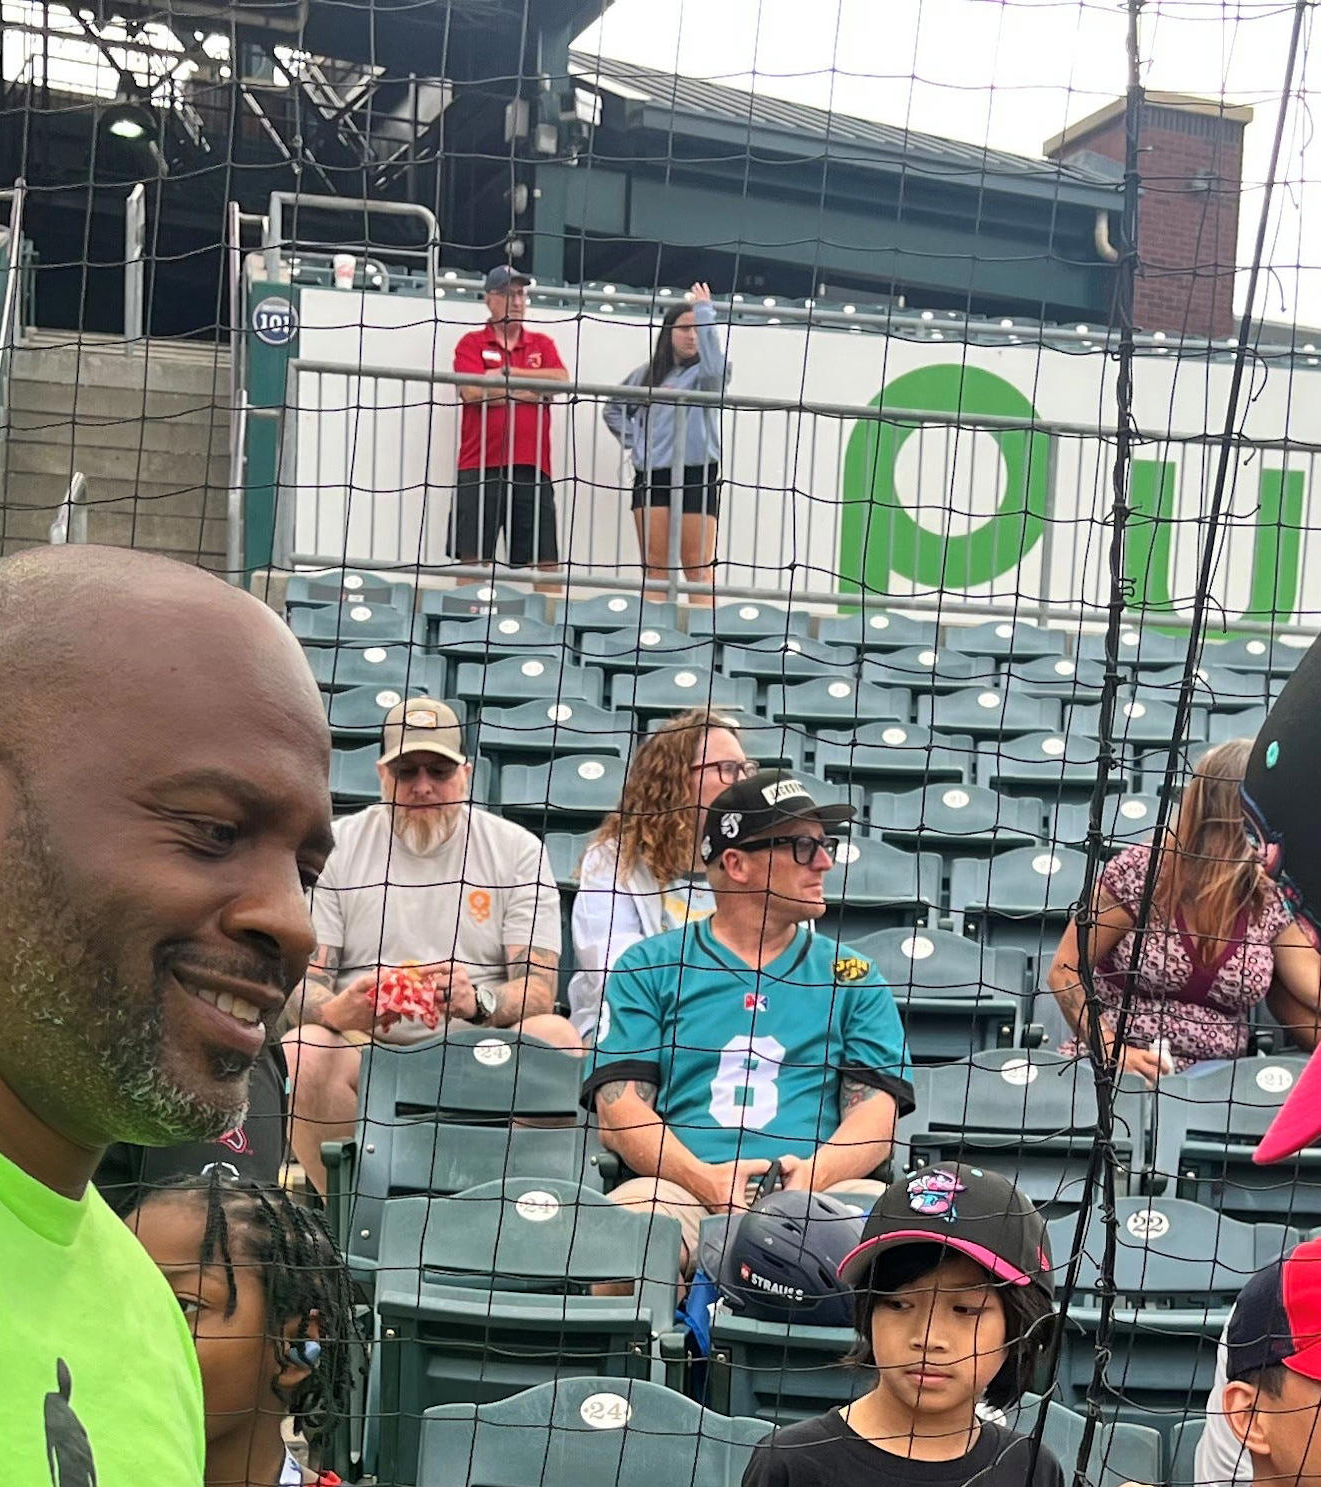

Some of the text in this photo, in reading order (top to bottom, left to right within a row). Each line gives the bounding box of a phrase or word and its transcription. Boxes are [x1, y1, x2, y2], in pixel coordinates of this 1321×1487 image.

[260, 313, 290, 333] 101
[478, 1047, 504, 1059] 24
[708, 1035, 786, 1129] 8
[1265, 1073, 1283, 1086] 21
[523, 1198, 551, 1214] 24
[1132, 1215, 1164, 1233] 22
[751, 1272, 804, 1302] STRAUSS
[589, 1401, 621, 1420] 24
